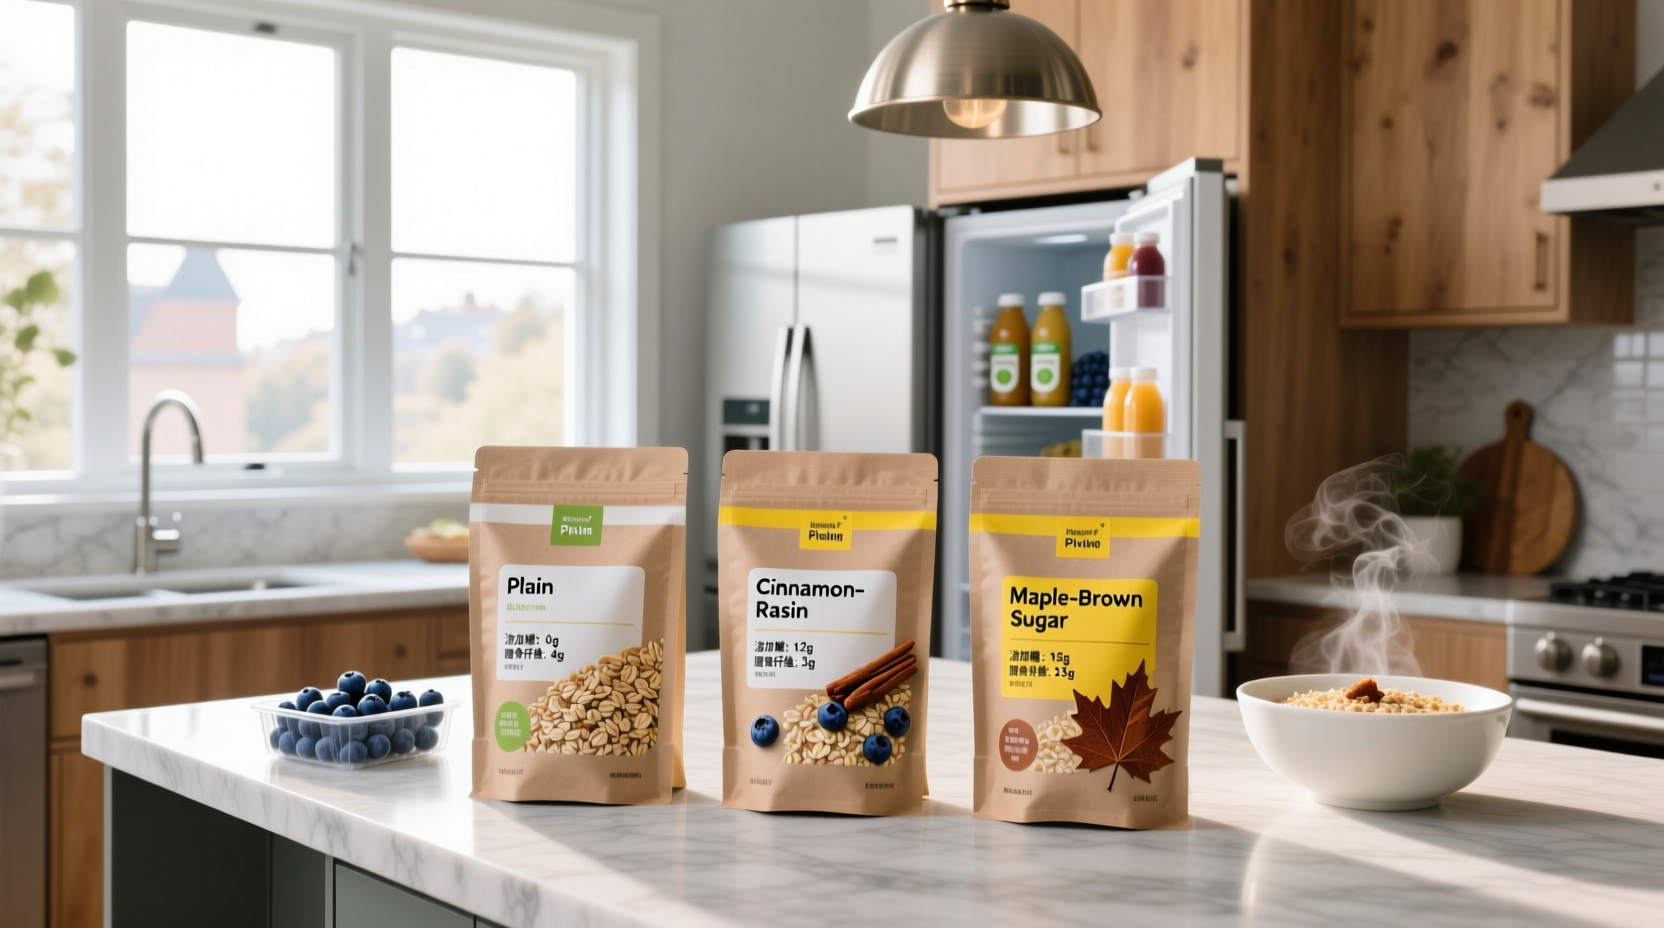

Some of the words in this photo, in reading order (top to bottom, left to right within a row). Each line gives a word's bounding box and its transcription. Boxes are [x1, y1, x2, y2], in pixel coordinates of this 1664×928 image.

[507, 576, 553, 595] Plain
[756, 578, 865, 598] Cinnamon-
[1010, 586, 1143, 610] Maple-Brown
[756, 601, 808, 619] Rasin
[1010, 609, 1069, 633] Sugar
[545, 634, 559, 648] 0g
[794, 641, 813, 655] 12g
[550, 649, 565, 662] 4g
[801, 656, 816, 670] 3g
